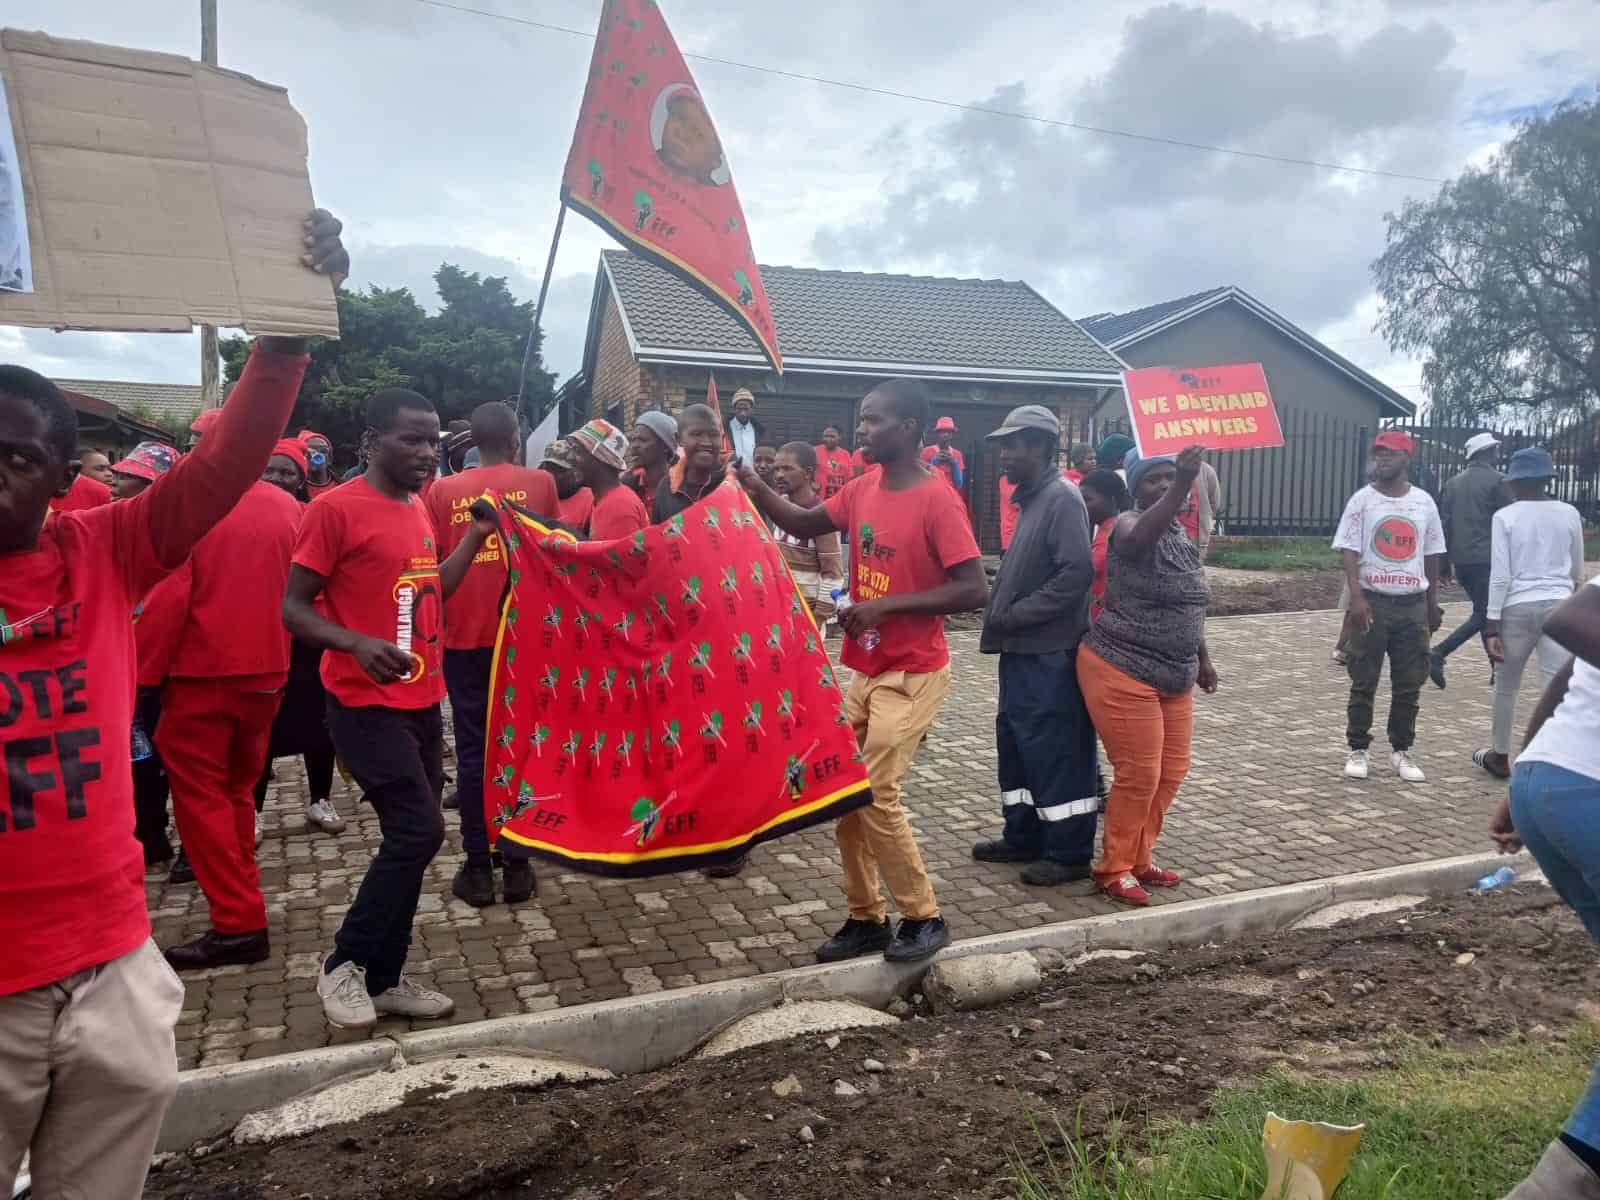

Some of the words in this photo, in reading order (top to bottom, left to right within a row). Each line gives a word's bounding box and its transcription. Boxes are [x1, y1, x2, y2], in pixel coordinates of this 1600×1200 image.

[1138, 396, 1170, 416] WE
[452, 496, 480, 510] LAN
[813, 756, 841, 779] EFF
[0, 727, 101, 833] FF
[532, 809, 567, 829] EFF
[664, 812, 698, 834] EFF
